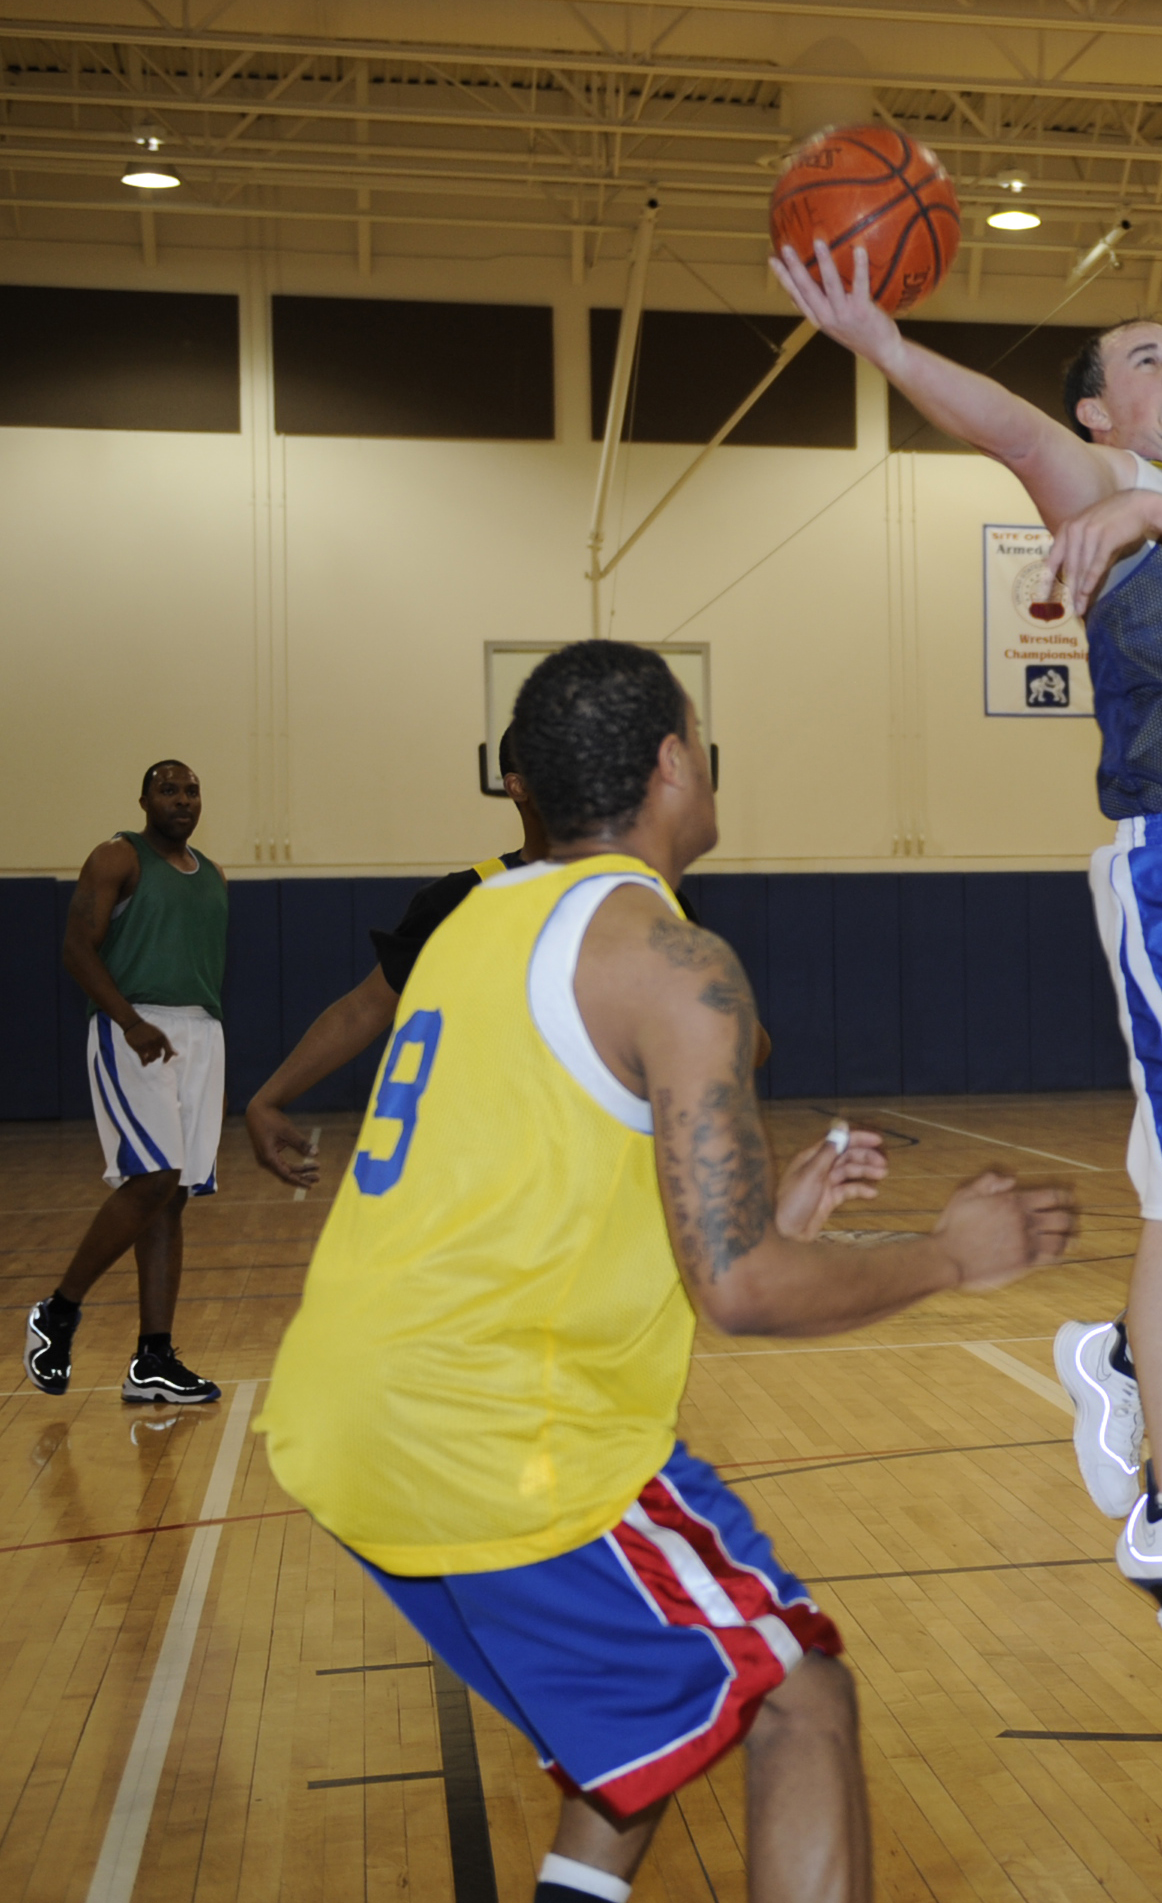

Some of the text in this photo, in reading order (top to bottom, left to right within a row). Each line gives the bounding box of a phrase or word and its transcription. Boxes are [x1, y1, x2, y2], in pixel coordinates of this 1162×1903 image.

[992, 532, 1019, 540] SITE
[996, 544, 1043, 555] Armed
[1019, 634, 1078, 648] Wrestling
[353, 1007, 444, 1196] 9
